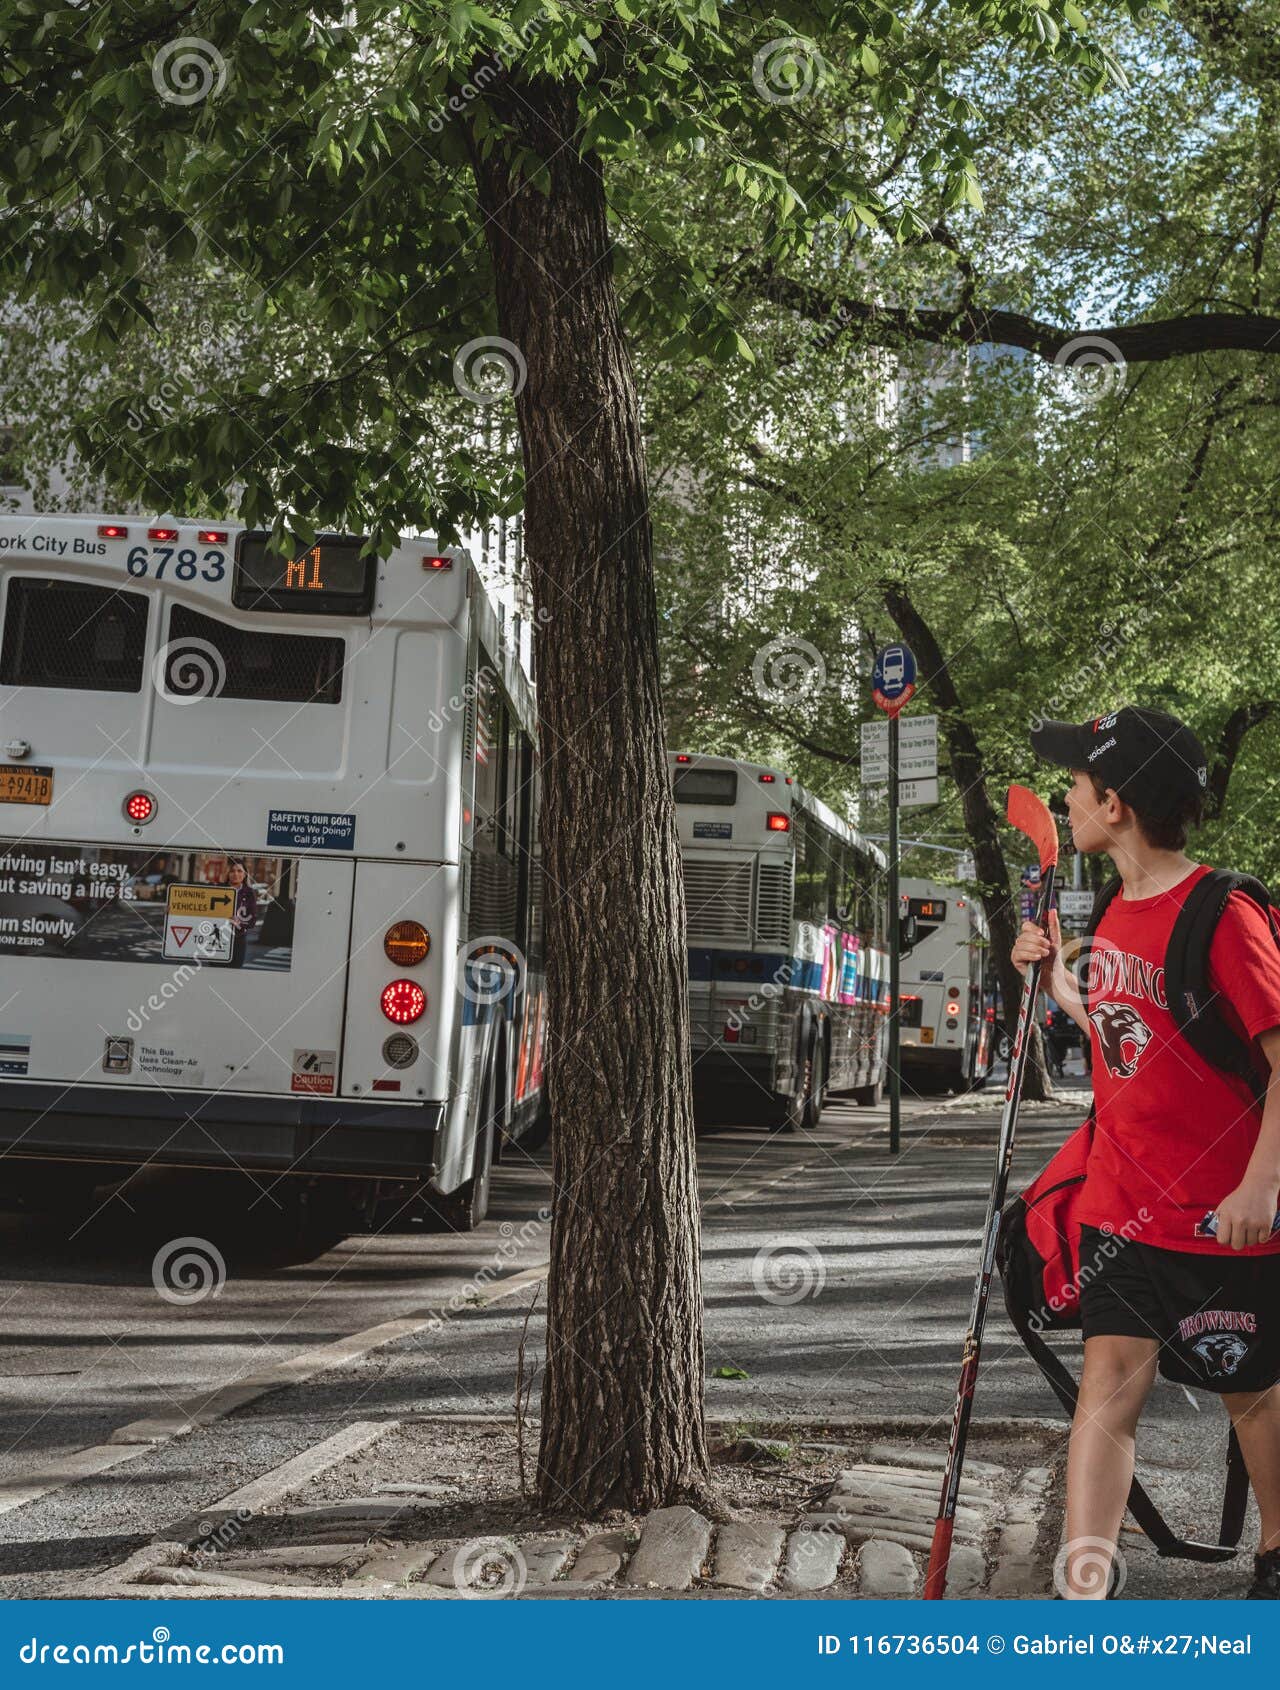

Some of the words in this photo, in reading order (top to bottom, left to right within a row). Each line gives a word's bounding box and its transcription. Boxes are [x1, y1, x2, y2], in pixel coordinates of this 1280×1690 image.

[32, 535, 68, 555] City
[73, 538, 107, 555] Bus
[127, 546, 225, 582] 6783
[286, 546, 324, 589] M1
[1088, 737, 1117, 762] Reebok
[271, 813, 310, 824] SAFETY'S
[312, 815, 329, 825] OUR
[331, 816, 352, 826] GOAL
[270, 823, 289, 832] How
[291, 824, 305, 833] Are
[307, 825, 320, 834] We
[322, 826, 351, 837] Doing?
[294, 835, 310, 844] Call
[312, 836, 325, 845] 511
[49, 856, 86, 875] isn't
[89, 862, 130, 881] easy,
[19, 878, 72, 900] saving
[75, 884, 86, 897] a
[89, 881, 115, 899] life
[119, 882, 137, 900] is.
[174, 889, 206, 899] TURNING
[171, 902, 208, 912] VEHICLES
[22, 917, 76, 939] slowly.
[17, 936, 45, 946] ZERO
[193, 935, 204, 944] TO
[141, 1047, 156, 1055] This
[160, 1048, 174, 1056] Bus
[140, 1056, 159, 1064] Uses
[161, 1057, 198, 1066] Clean-Air
[140, 1064, 183, 1075] Technology
[294, 1075, 333, 1085] Caution
[1179, 1310, 1257, 1342] BROWNING
